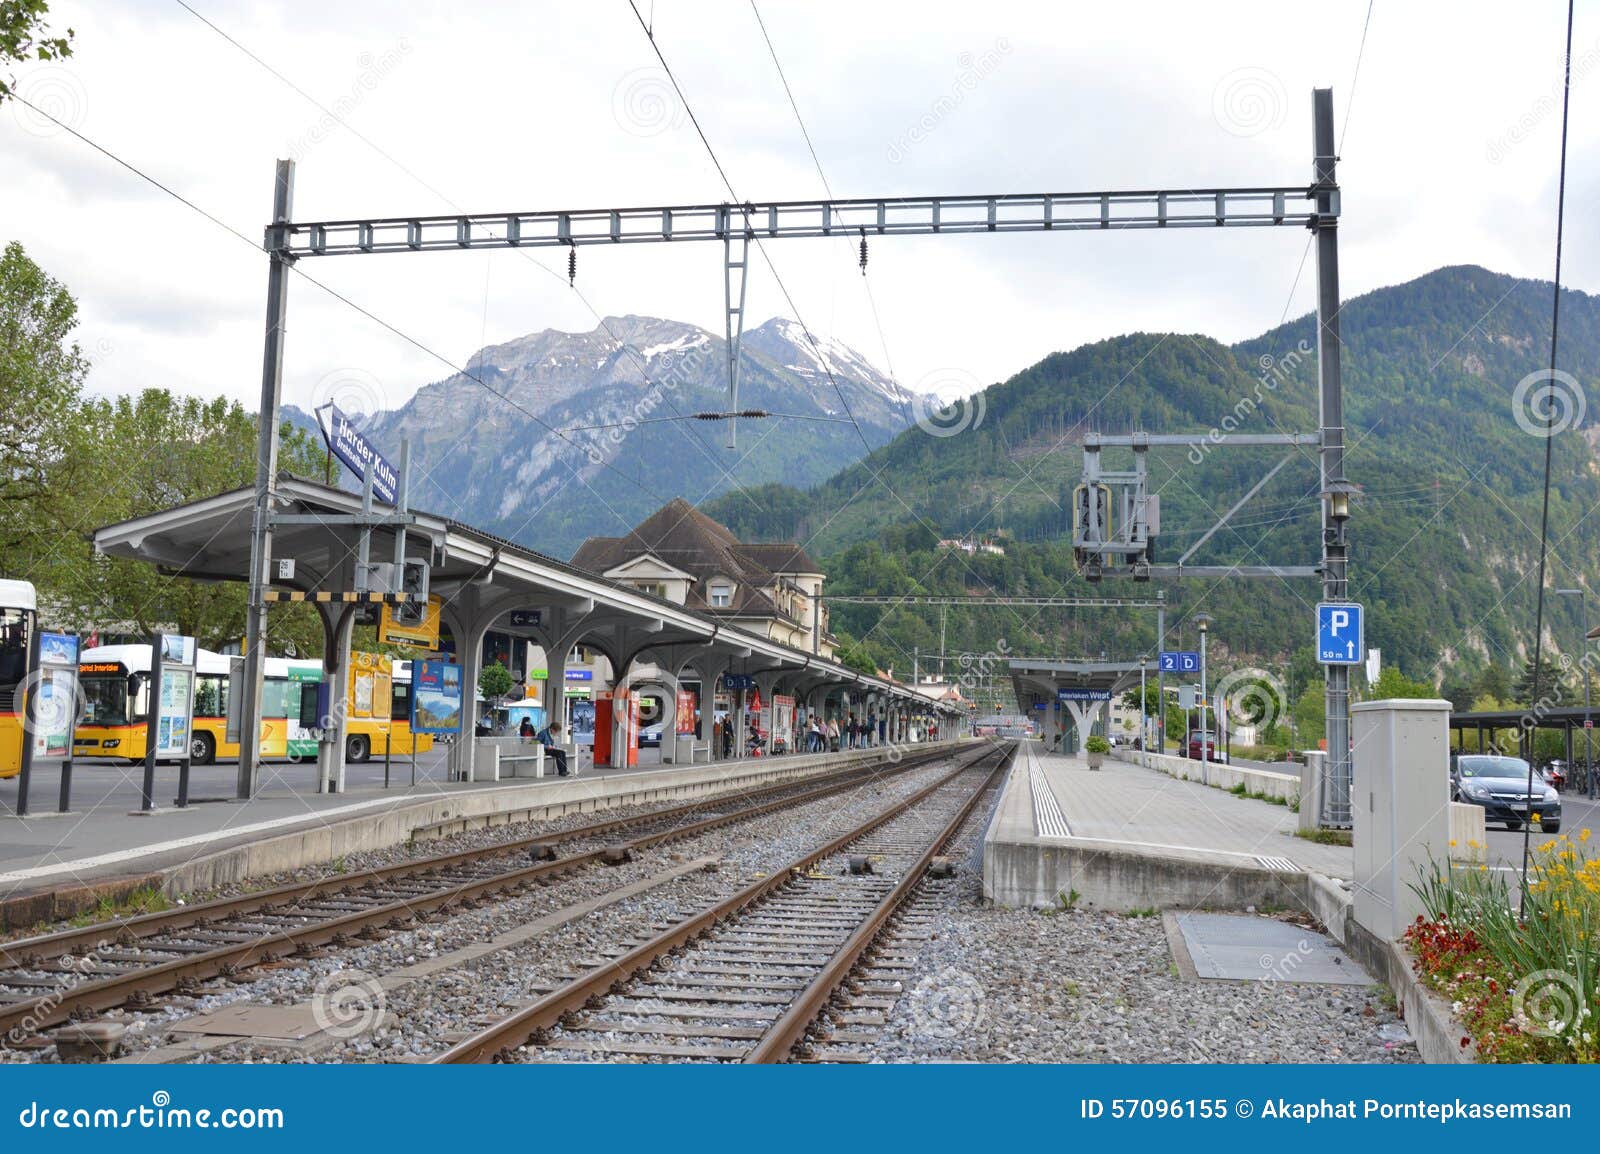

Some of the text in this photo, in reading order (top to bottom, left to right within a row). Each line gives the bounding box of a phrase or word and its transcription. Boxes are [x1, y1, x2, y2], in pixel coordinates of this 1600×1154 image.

[339, 418, 373, 463] Harder
[374, 453, 396, 490] Kulm
[1331, 611, 1349, 637] P
[1323, 651, 1334, 659] 50
[1165, 658, 1193, 669] 2 D
[727, 679, 734, 687] D
[1089, 691, 1110, 699] West
